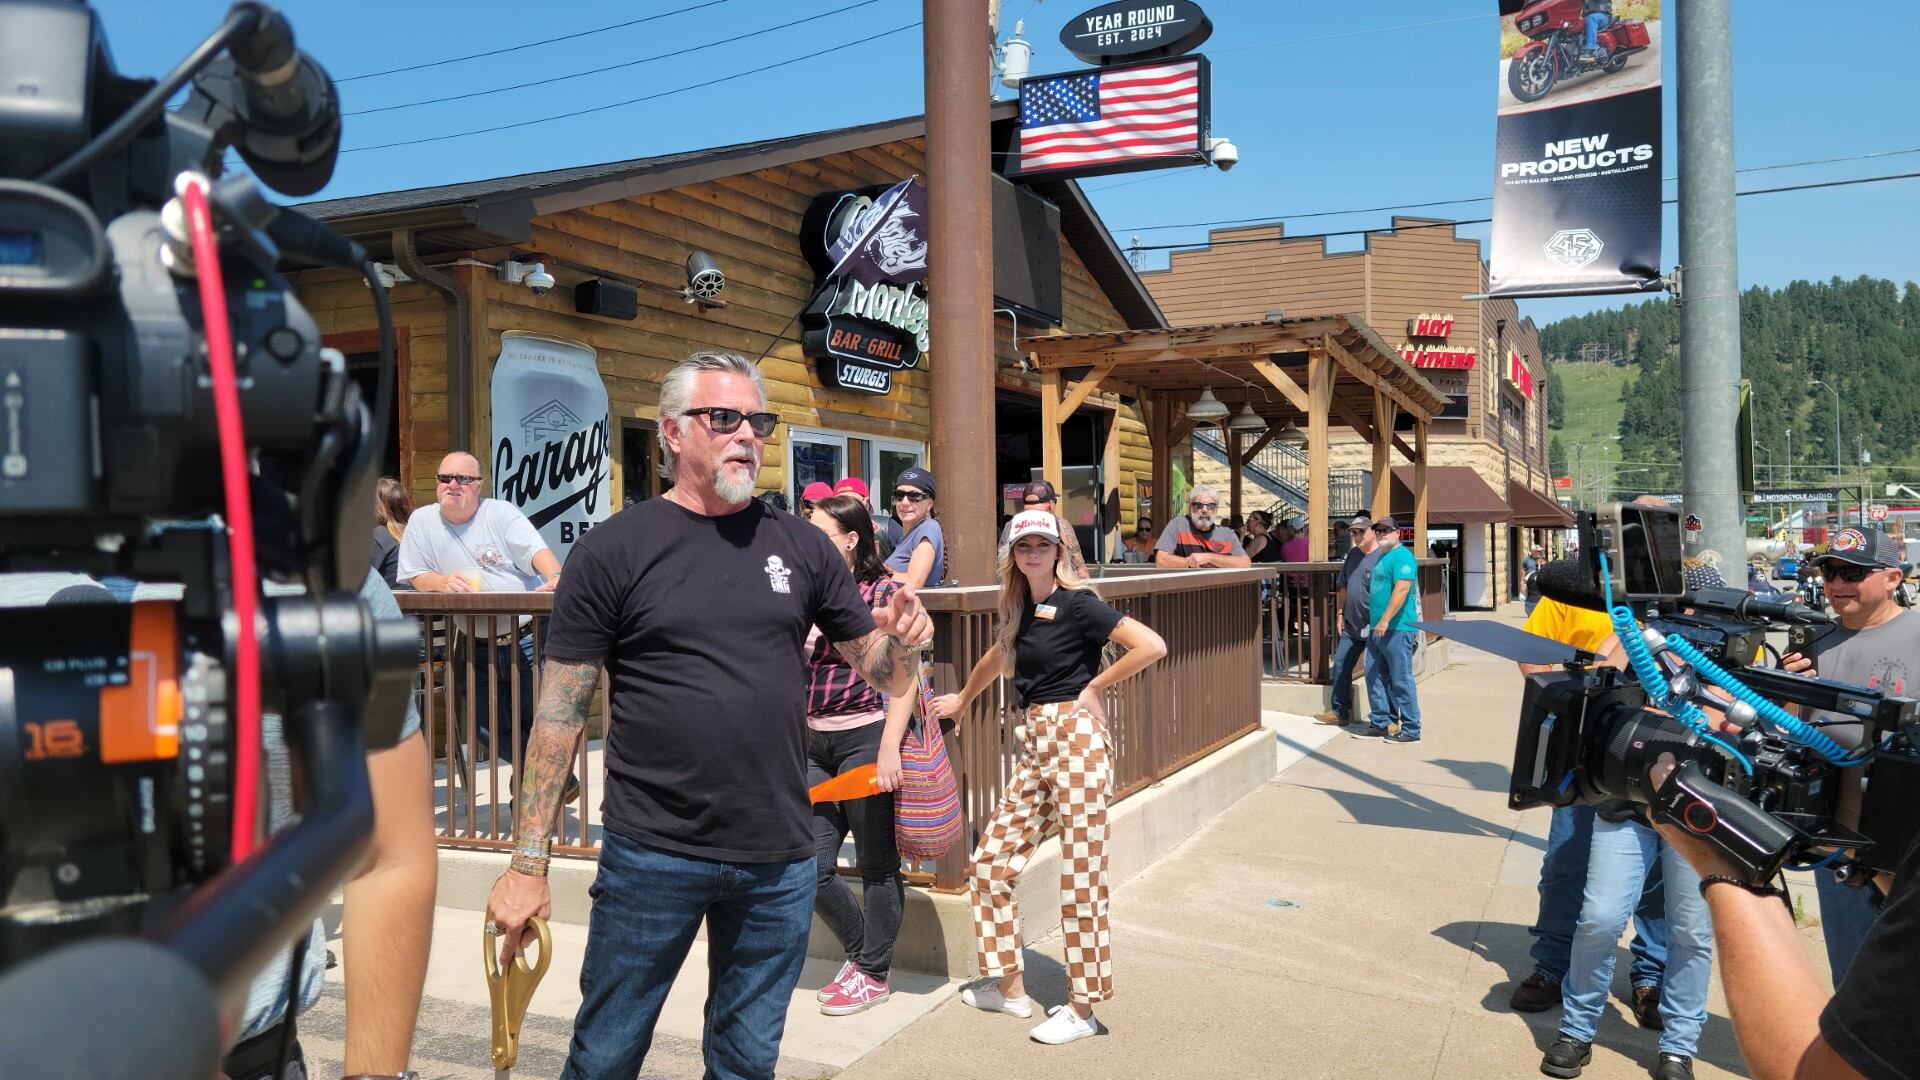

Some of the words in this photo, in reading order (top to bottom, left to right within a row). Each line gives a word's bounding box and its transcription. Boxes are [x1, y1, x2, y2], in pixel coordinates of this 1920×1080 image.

[1086, 12, 1122, 32] YEAR
[1128, 5, 1175, 26] ROUND
[1098, 33, 1124, 46] EST.
[1131, 26, 1162, 41] 2024
[1545, 134, 1609, 157] NEW
[1502, 144, 1653, 177] PRODUCTS
[1601, 164, 1648, 176] INSTALLATIONS
[1413, 316, 1455, 337] HOT
[831, 329, 861, 350] BAR
[867, 339, 902, 360] GRILL
[1396, 347, 1475, 369] EATHERS
[840, 364, 889, 388] STURGIS
[494, 412, 609, 515] Garage
[24, 719, 84, 760] 16
